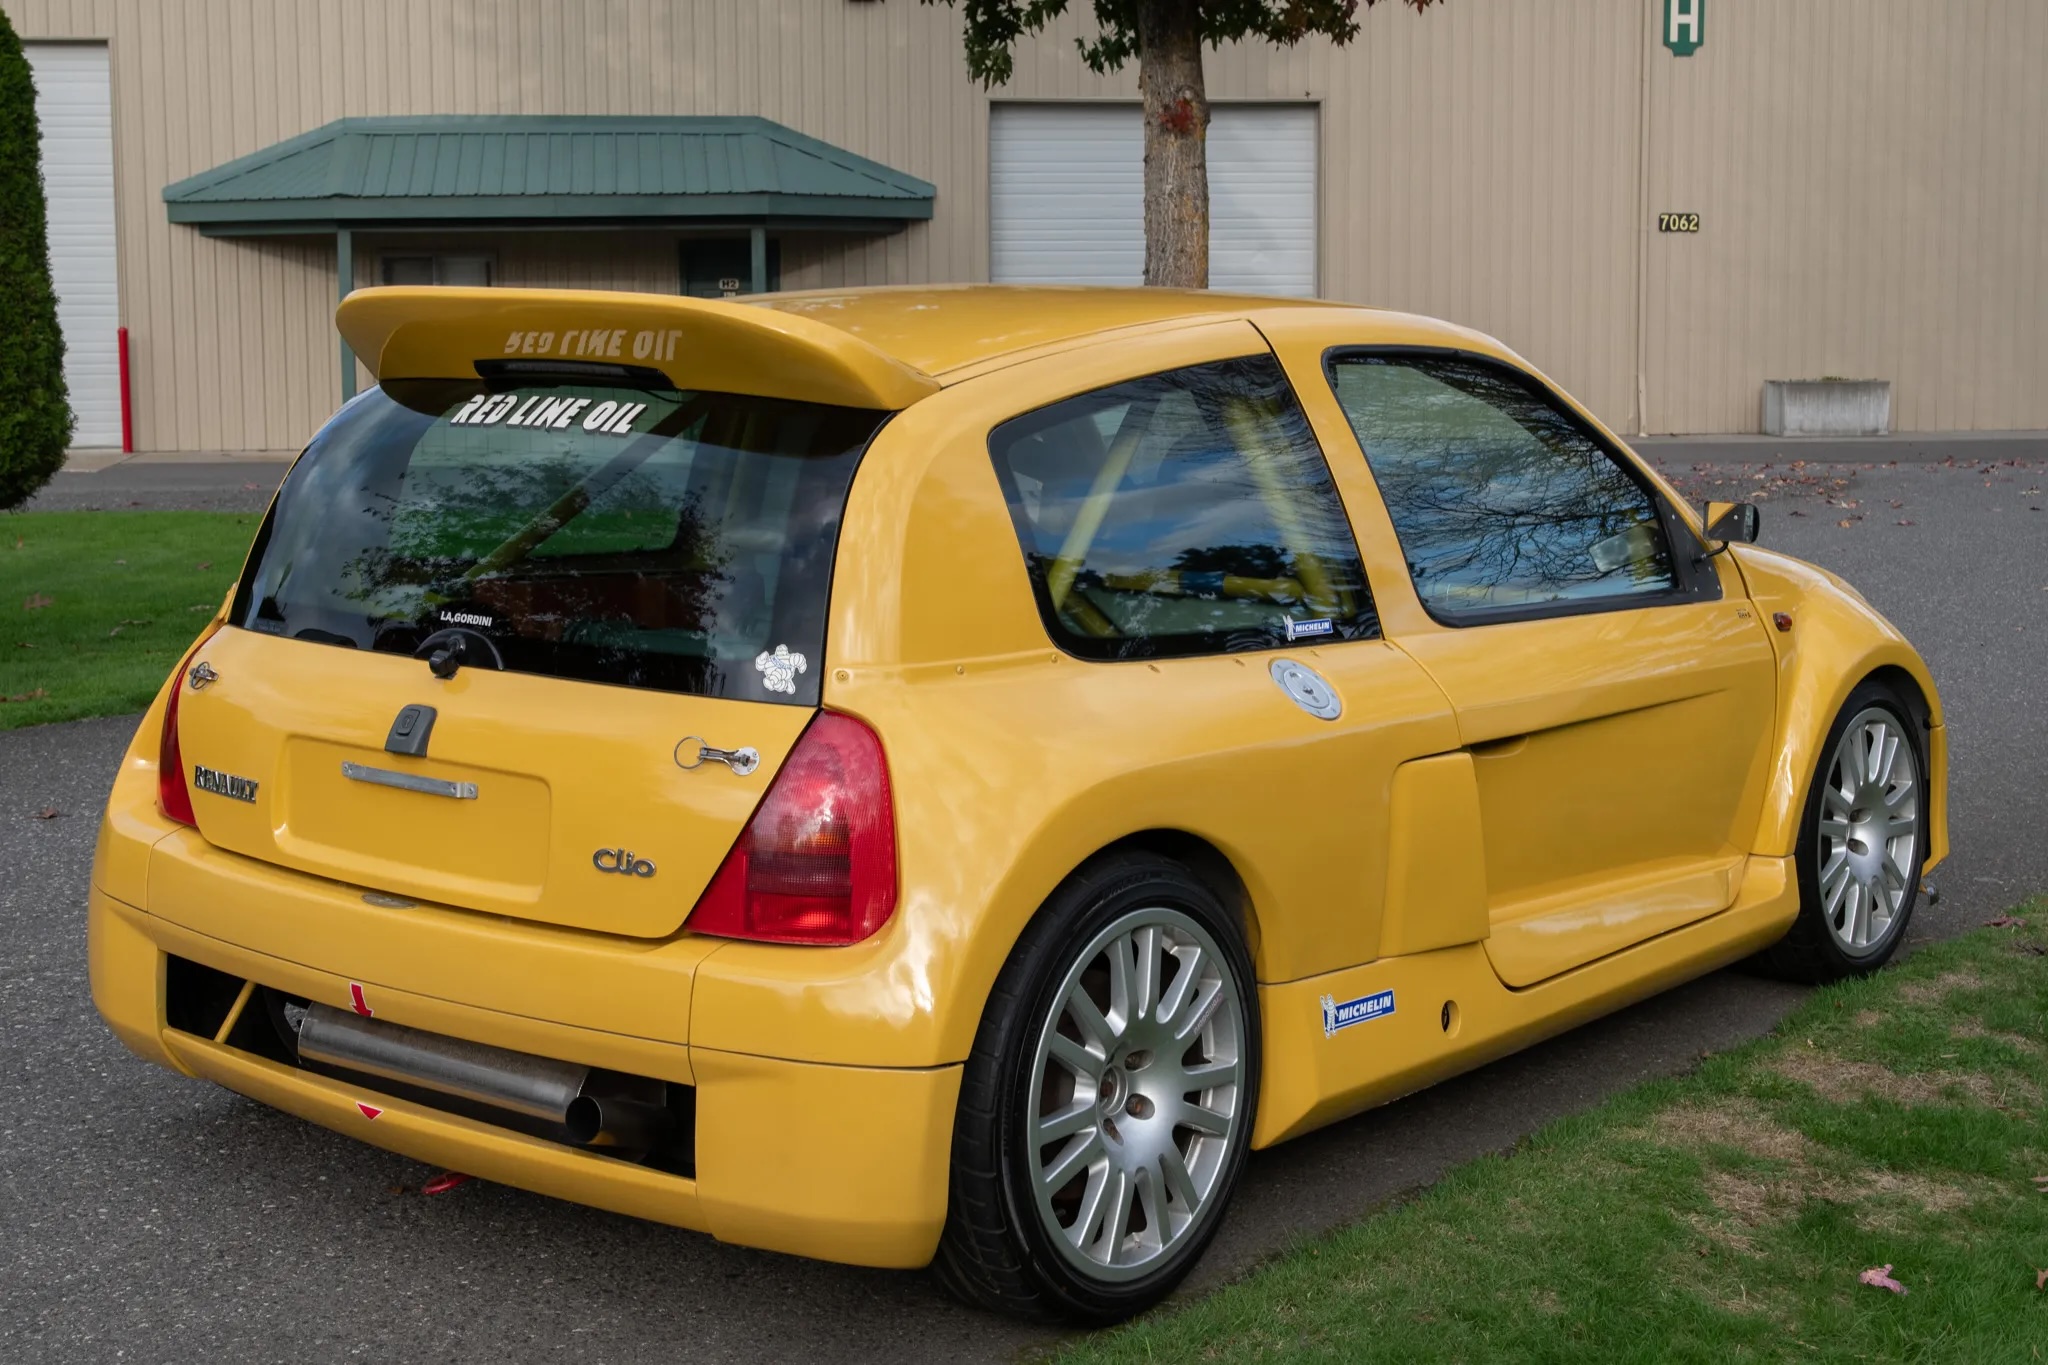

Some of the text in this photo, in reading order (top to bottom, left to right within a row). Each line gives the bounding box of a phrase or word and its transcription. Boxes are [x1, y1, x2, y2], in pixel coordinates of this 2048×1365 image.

[1670, 0, 1699, 42] H
[1660, 214, 1698, 231] 7062
[722, 279, 737, 289] H2
[450, 394, 648, 434] RED LINE OIL
[1295, 621, 1330, 633] MICHELIN
[194, 764, 259, 804] RENAULT
[592, 847, 657, 878] Clio
[1338, 995, 1392, 1022] MICHELIN
